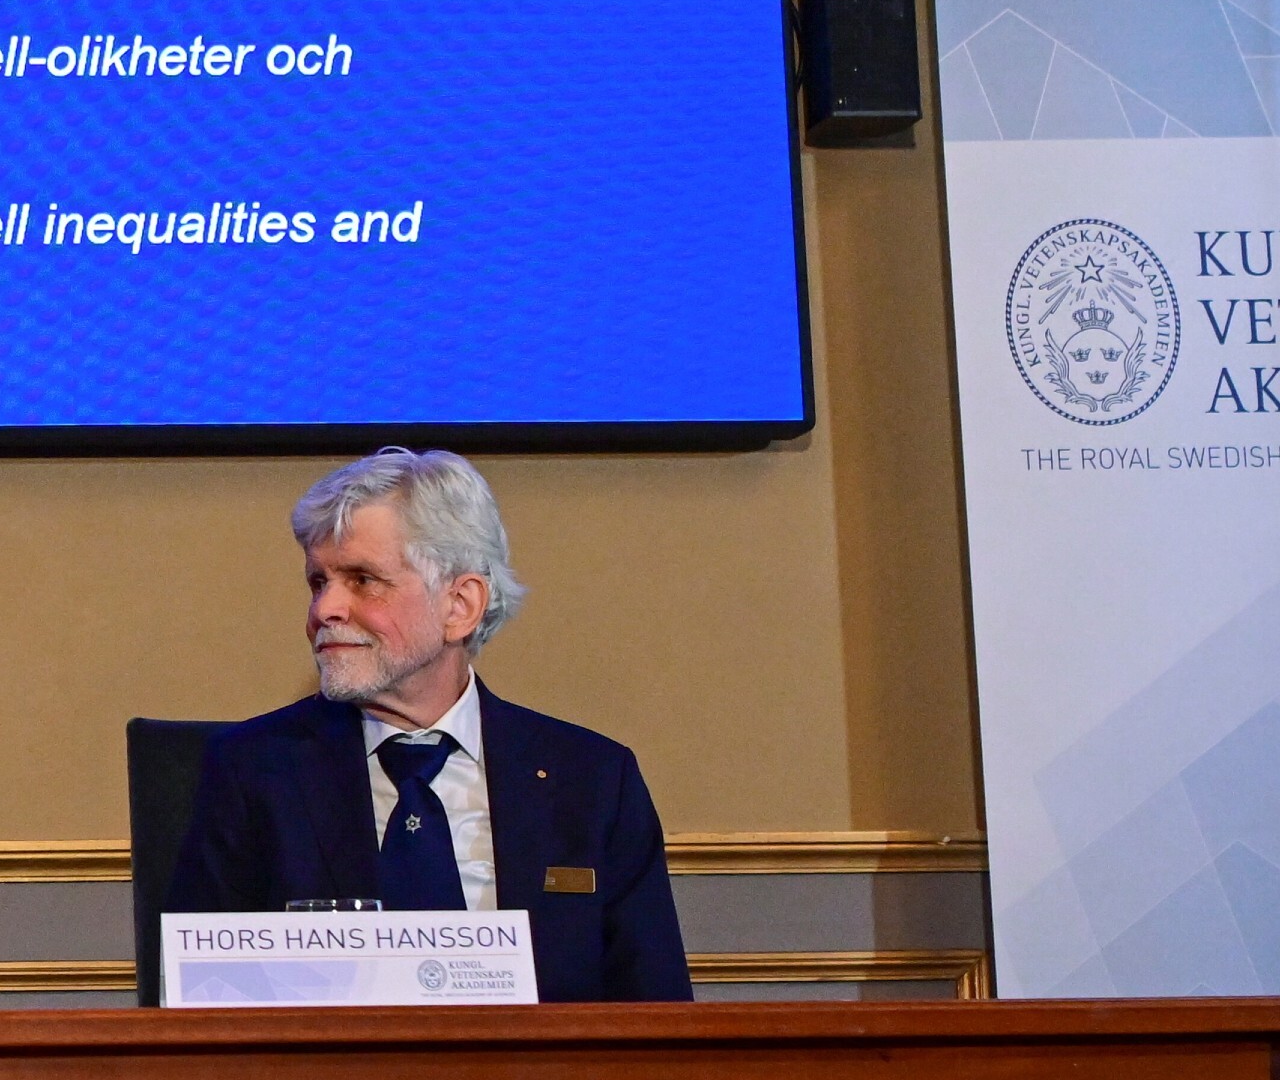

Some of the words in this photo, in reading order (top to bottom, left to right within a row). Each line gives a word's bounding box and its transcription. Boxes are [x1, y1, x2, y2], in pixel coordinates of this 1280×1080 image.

[266, 34, 353, 76] och
[43, 203, 317, 255] inequalities
[331, 203, 423, 243] and
[1019, 229, 1169, 368] VETENSKAPSAKADEMIEN
[1197, 298, 1280, 345] VE
[1016, 294, 1042, 368] KUNGL.
[1020, 448, 1072, 471] THE
[1080, 447, 1161, 470] ROYAL
[1167, 445, 1280, 469] SWEDISH
[177, 929, 275, 950] THORS
[285, 928, 365, 950] HANS
[375, 926, 517, 949] HANSSON
